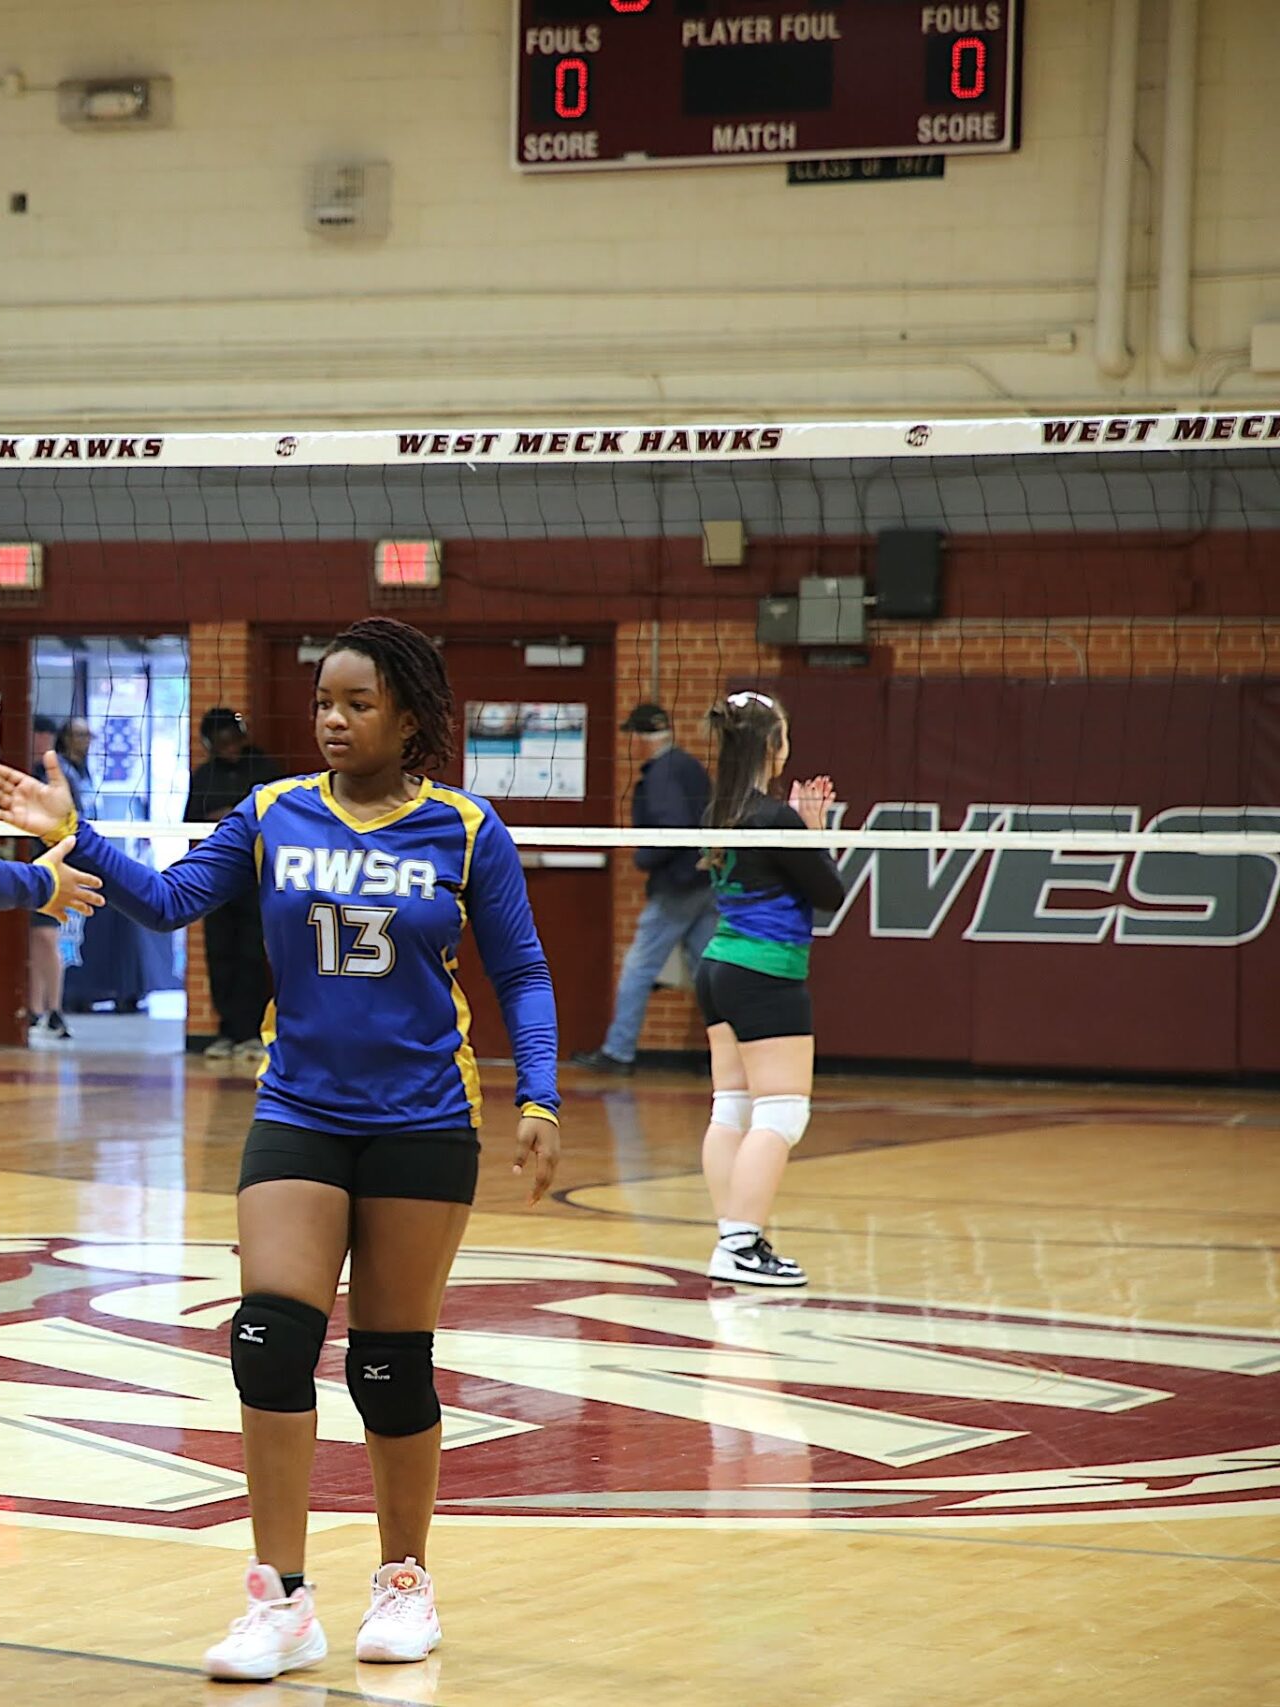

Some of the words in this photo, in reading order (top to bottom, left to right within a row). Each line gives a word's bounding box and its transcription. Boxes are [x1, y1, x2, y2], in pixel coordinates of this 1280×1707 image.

[682, 18, 772, 46] PLAYER
[781, 14, 841, 41] FOUL
[922, 4, 999, 33] FOULS
[526, 26, 601, 54] FOULS
[951, 37, 986, 98] 0
[555, 58, 588, 118] 0
[712, 122, 796, 152] MATCH
[917, 113, 996, 142] SCORE
[523, 131, 599, 161] SCORE
[398, 433, 500, 455] WEST
[512, 431, 625, 454] MECK
[637, 428, 784, 453] HAWKS
[1042, 418, 1160, 445] WEST
[32, 438, 163, 460] HAWKS
[274, 845, 437, 900] RWSA
[307, 902, 398, 978] 13
